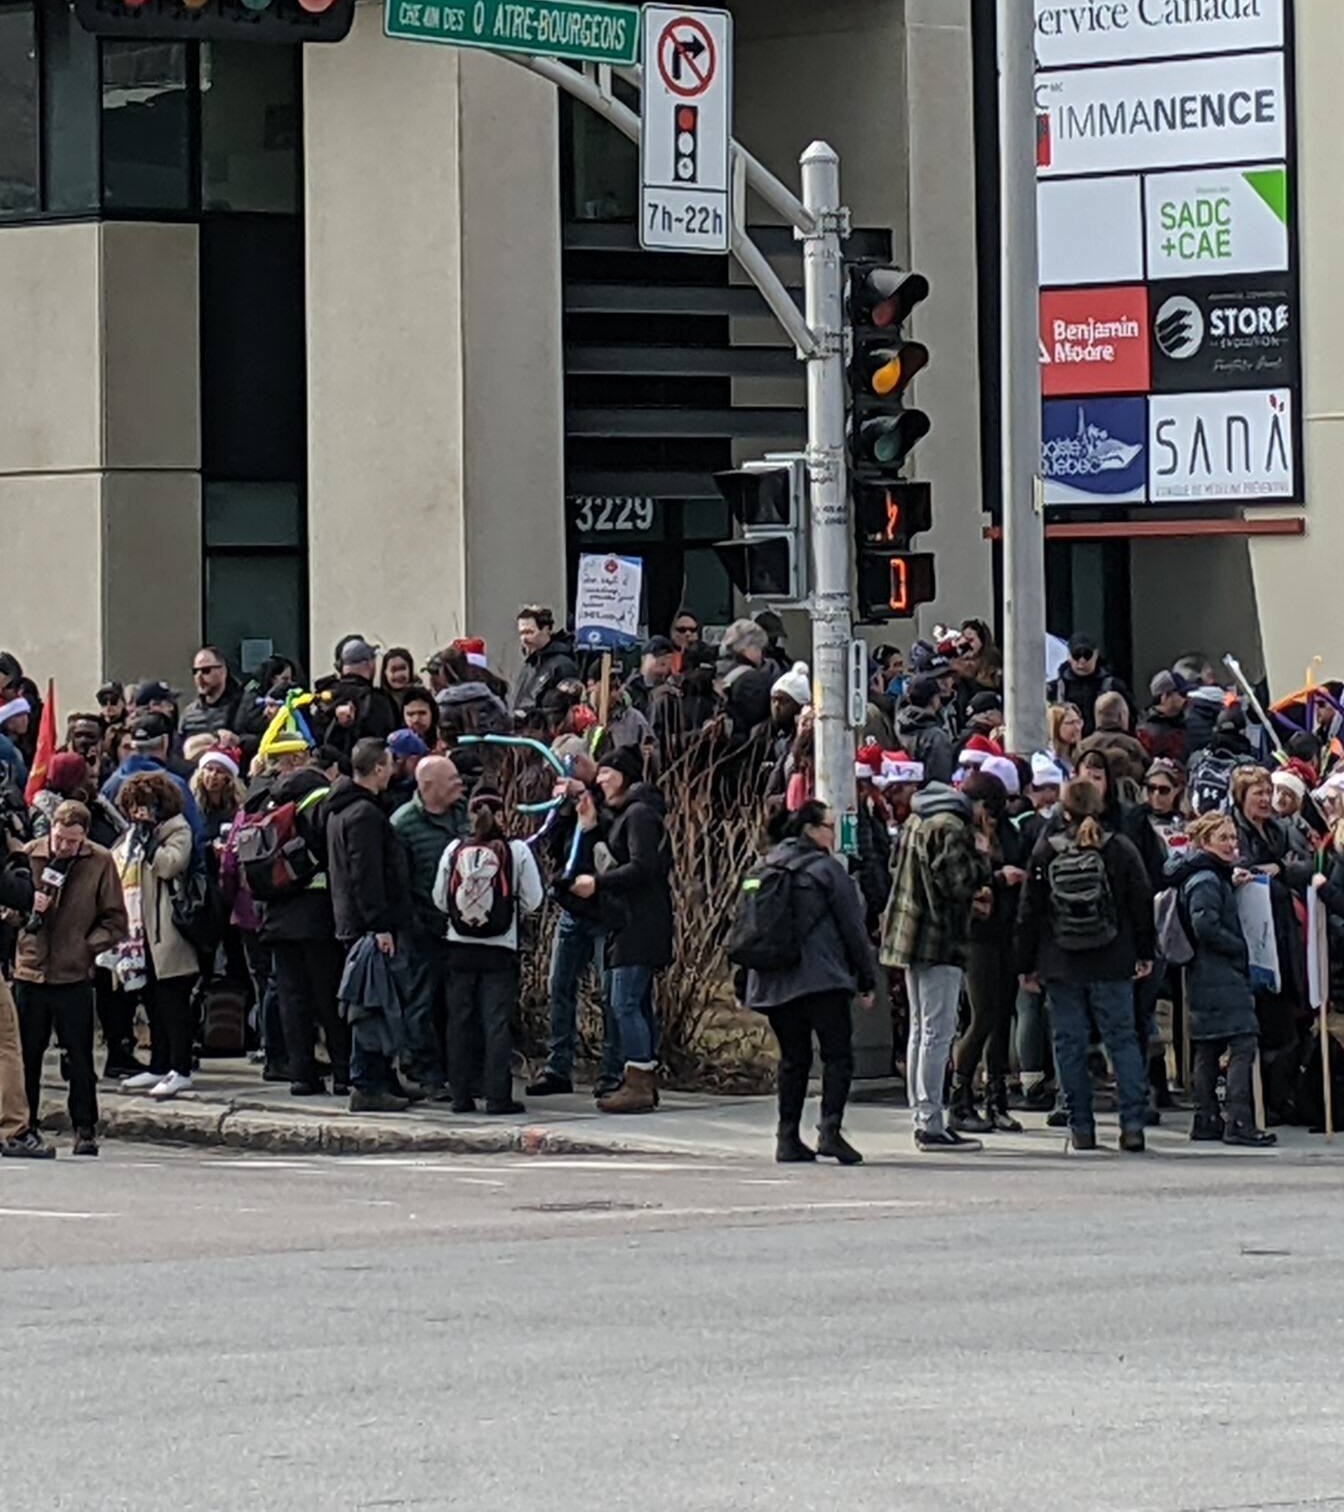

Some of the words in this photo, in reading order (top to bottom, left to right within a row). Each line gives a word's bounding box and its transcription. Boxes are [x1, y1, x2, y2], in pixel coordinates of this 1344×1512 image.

[443, 6, 466, 32] DES
[472, 0, 627, 51] QATRE-BOURGEOIS
[1059, 89, 1276, 139] IMMANENCE
[1160, 198, 1231, 230] SADC
[1160, 228, 1232, 259] +CAE
[1053, 315, 1140, 343] Benjamin
[1210, 304, 1289, 336] STORE
[1054, 341, 1115, 364] Moore
[575, 496, 654, 531] 3229
